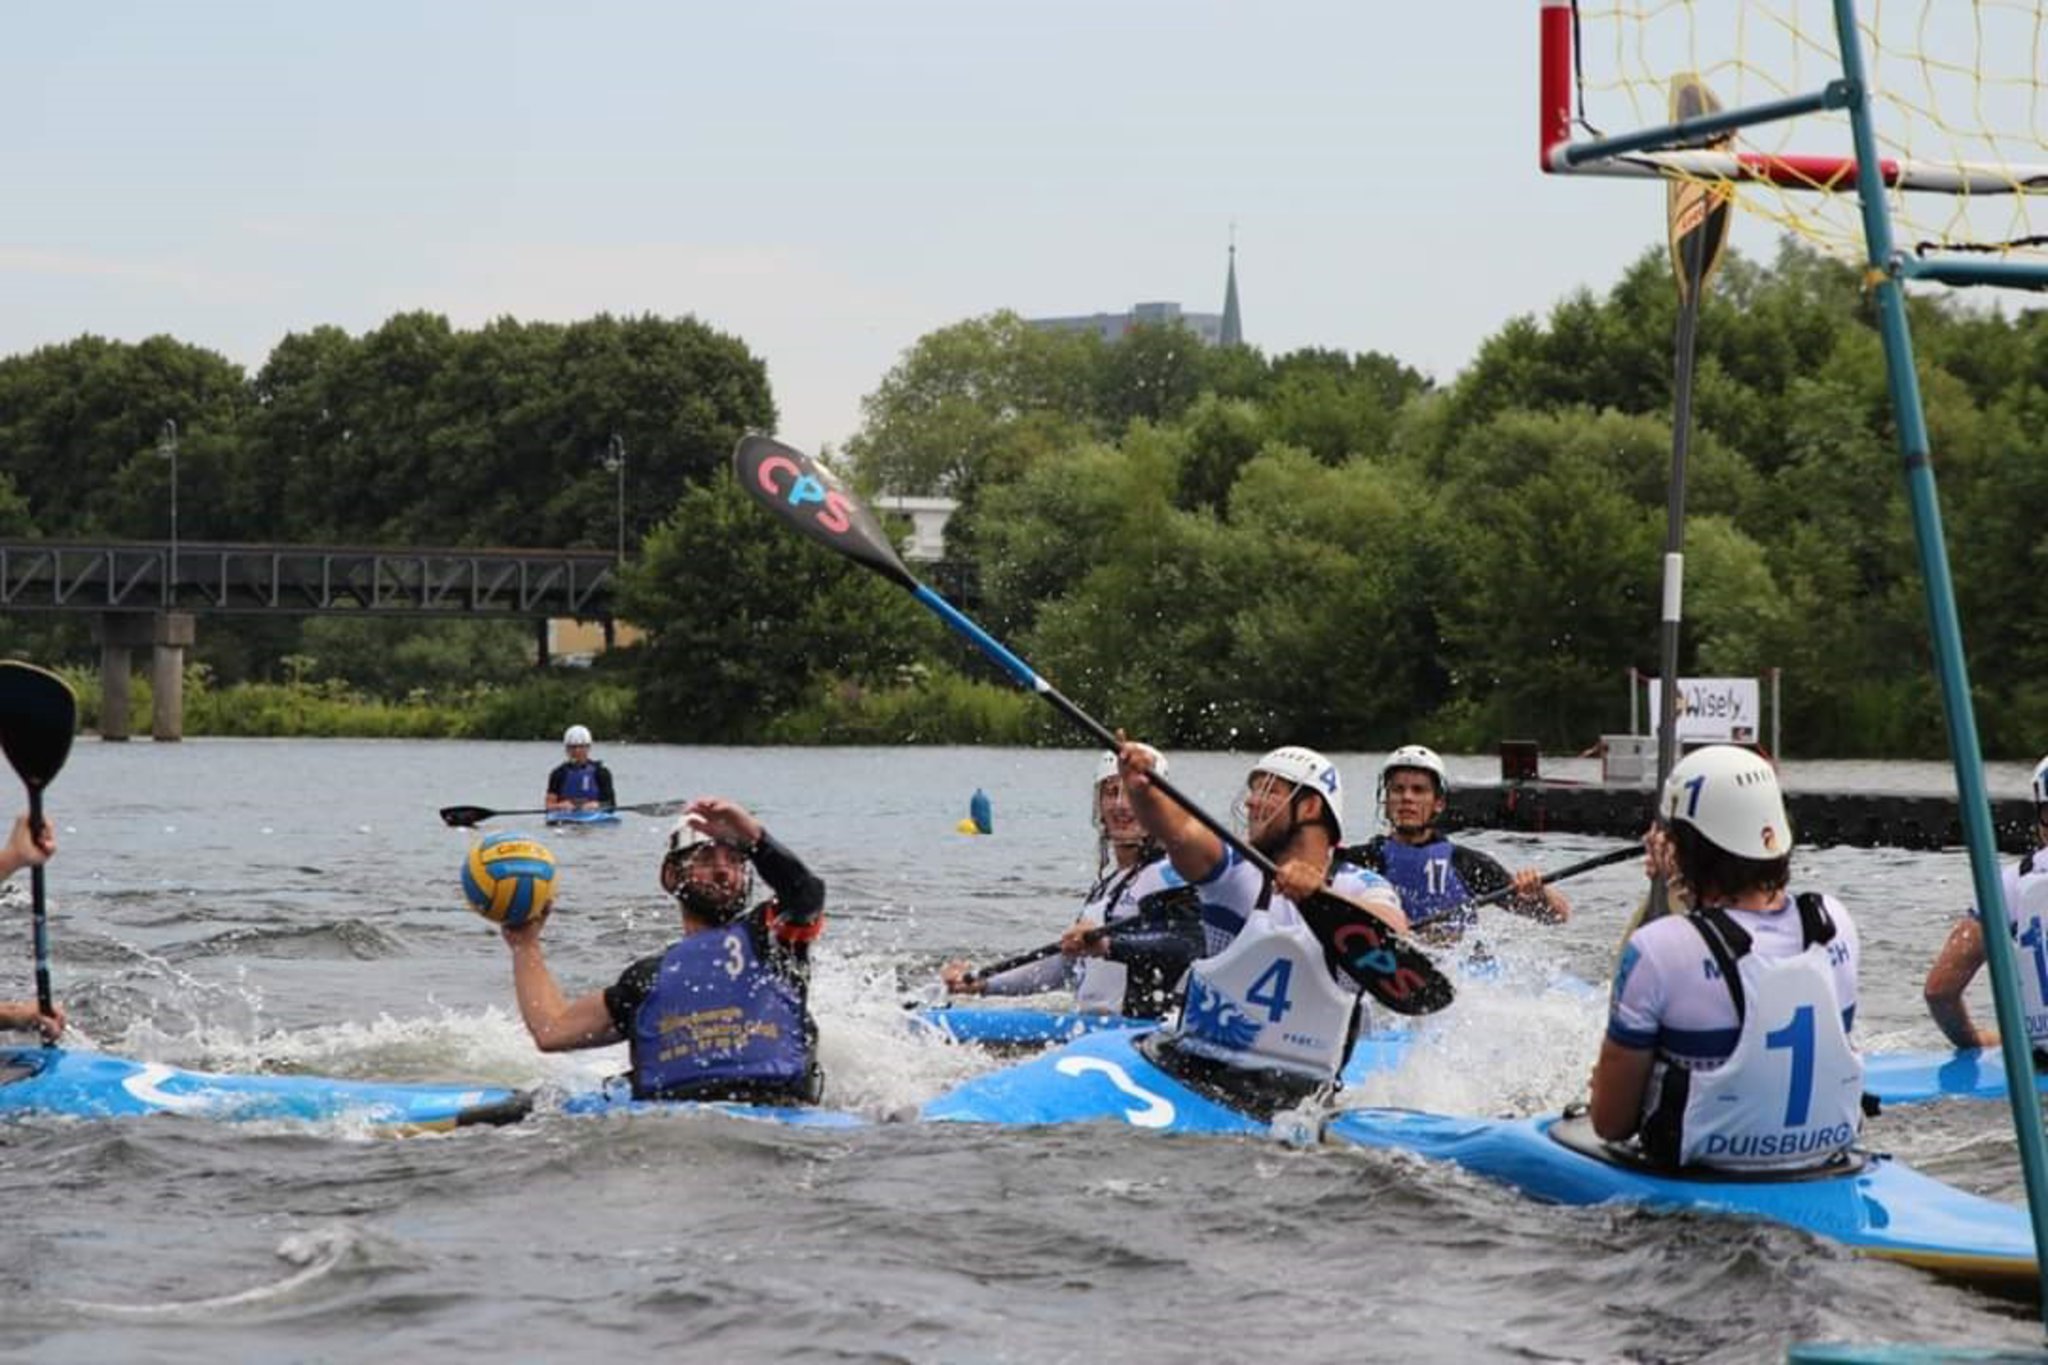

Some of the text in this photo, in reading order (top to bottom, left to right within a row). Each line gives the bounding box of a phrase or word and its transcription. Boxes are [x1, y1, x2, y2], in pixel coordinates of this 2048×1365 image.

[757, 455, 850, 534] CPS
[1319, 766, 1337, 793] 4
[1684, 774, 1706, 817] 1
[1423, 858, 1448, 895] 17
[724, 935, 744, 977] 3
[1334, 924, 1427, 1000] CPS
[1246, 957, 1293, 1023] 4
[1765, 1005, 1815, 1128] 1
[1706, 1123, 1852, 1157] DUISBURG
